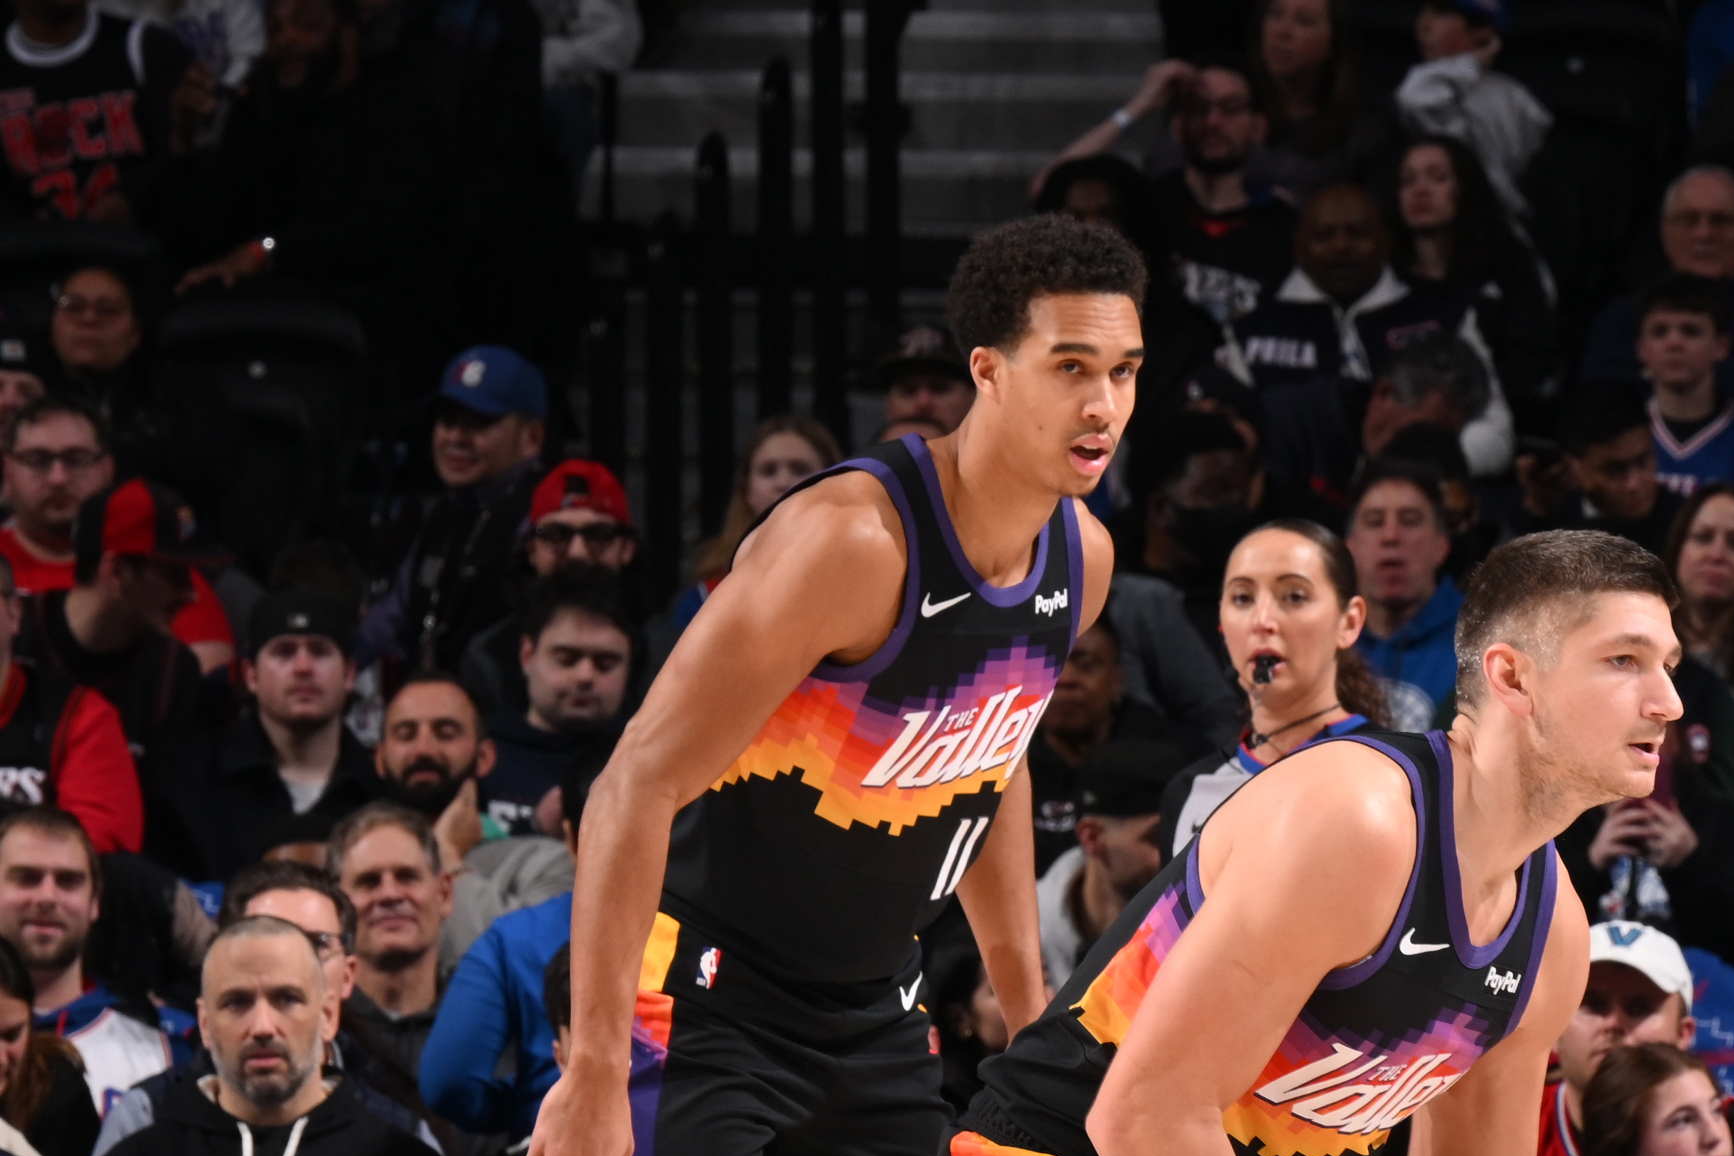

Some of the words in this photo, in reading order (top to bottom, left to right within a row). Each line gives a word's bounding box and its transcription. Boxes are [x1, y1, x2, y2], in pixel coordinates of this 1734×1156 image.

[1034, 588, 1068, 618] PayPal
[944, 708, 978, 731] THE
[861, 685, 1054, 788] Valley
[931, 817, 989, 900] 11
[1484, 965, 1522, 995] PayPal
[1368, 1064, 1408, 1082] THE
